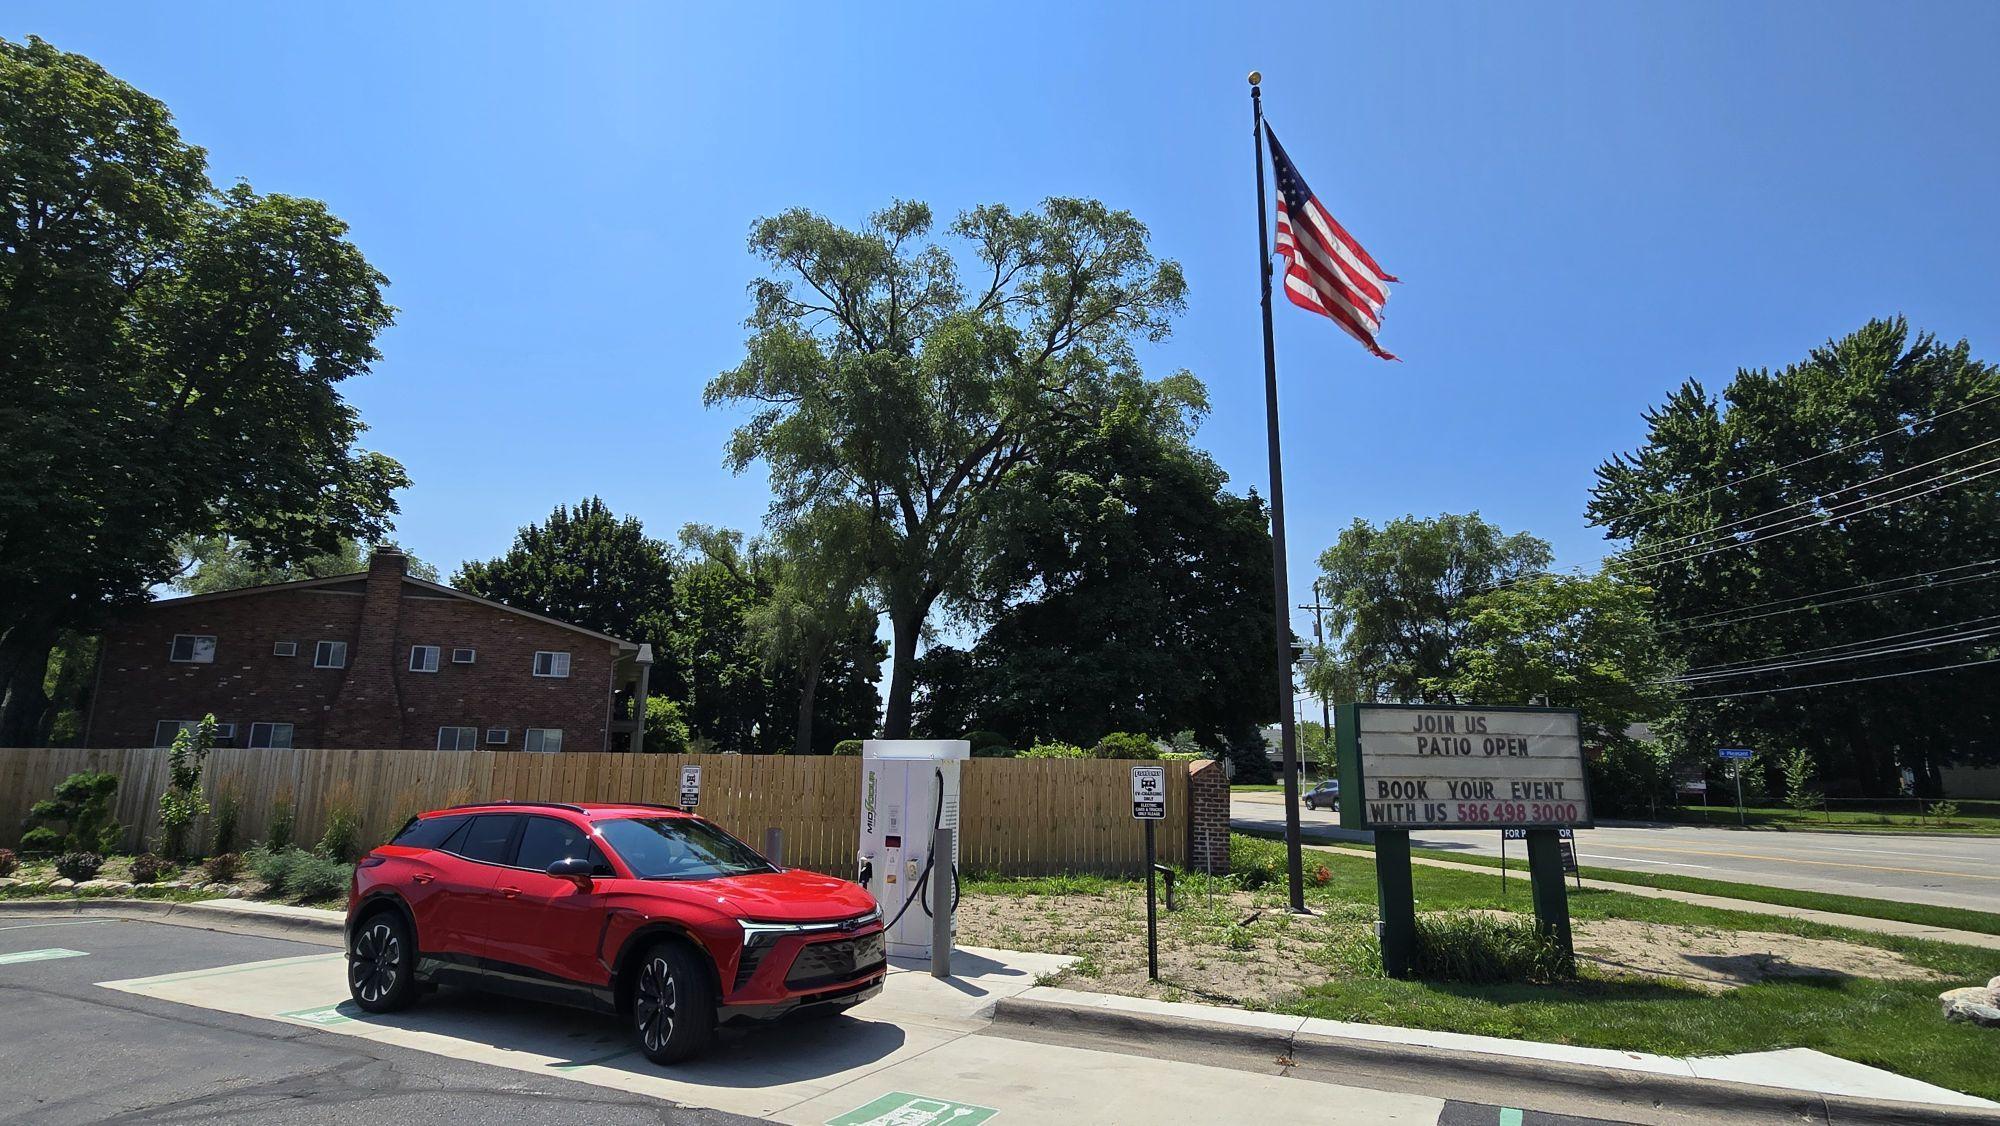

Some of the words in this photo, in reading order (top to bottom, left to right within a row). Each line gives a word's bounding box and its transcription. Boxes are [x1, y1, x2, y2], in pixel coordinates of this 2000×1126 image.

[1413, 714, 1455, 734] JOIN
[1466, 716, 1488, 734] US
[1417, 736, 1471, 756] PATIO
[1483, 738, 1529, 756] OPEN
[1378, 780, 1428, 800] BOOK
[1447, 781, 1495, 800] YOUR
[1511, 781, 1564, 800] EVENT
[1371, 803, 1416, 823] WITH
[1425, 803, 1447, 822] US
[1457, 803, 1489, 822] 586
[1494, 803, 1526, 822] 498
[1532, 803, 1578, 822] 3000
[1505, 829, 1520, 838] FOR
[1558, 829, 1571, 837] OR
